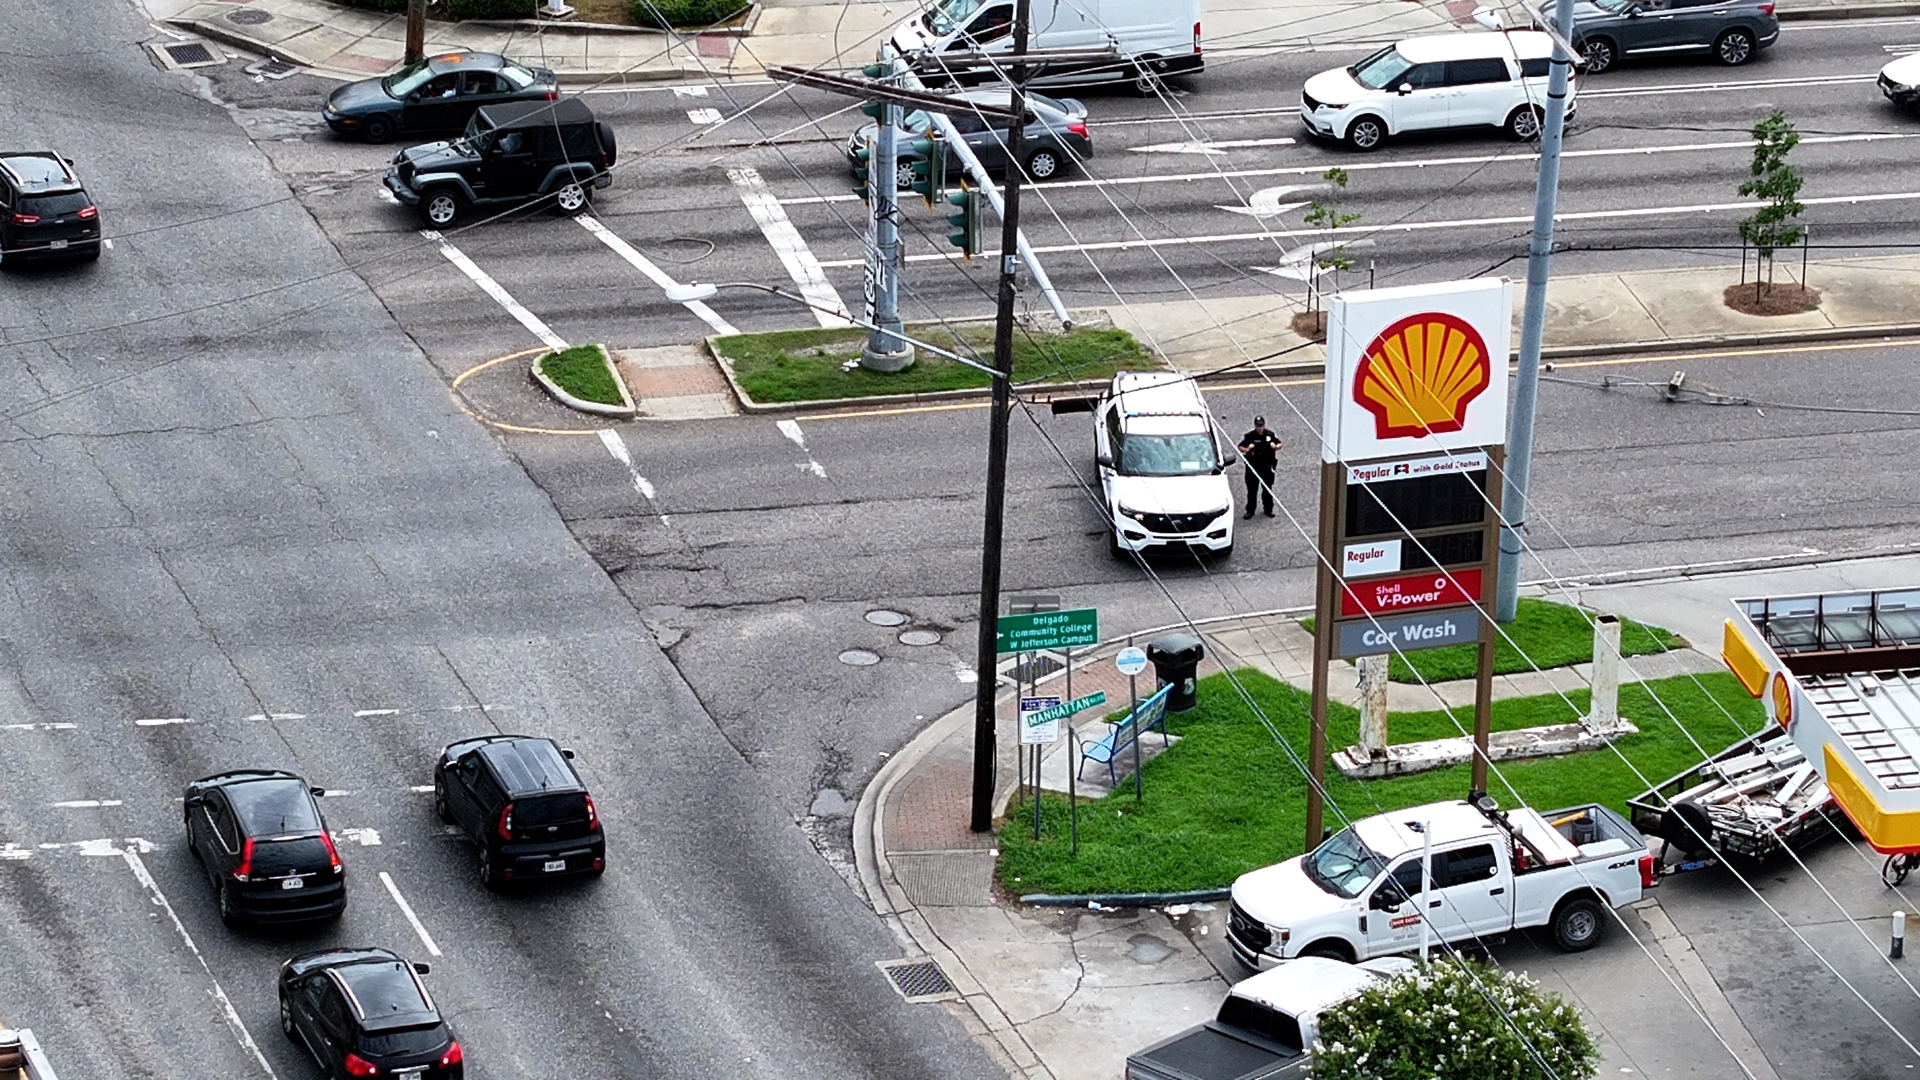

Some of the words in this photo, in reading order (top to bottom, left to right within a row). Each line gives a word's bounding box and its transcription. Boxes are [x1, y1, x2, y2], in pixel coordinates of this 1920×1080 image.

[1353, 466, 1391, 481] Regular
[1413, 464, 1431, 473] with
[1433, 461, 1453, 471] Gold
[1347, 547, 1385, 563] Regular
[1376, 584, 1401, 595] Shell
[1376, 591, 1441, 608] V-Power
[1033, 614, 1069, 626] Delgado
[1009, 626, 1057, 639] Community
[1060, 623, 1093, 634] College
[1362, 629, 1398, 646] Car
[1402, 619, 1456, 642] Wash
[1009, 641, 1018, 649] W
[1020, 636, 1058, 649] Jefferson
[1060, 634, 1094, 645] Campus
[1028, 697, 1091, 727] MANHATTAN
